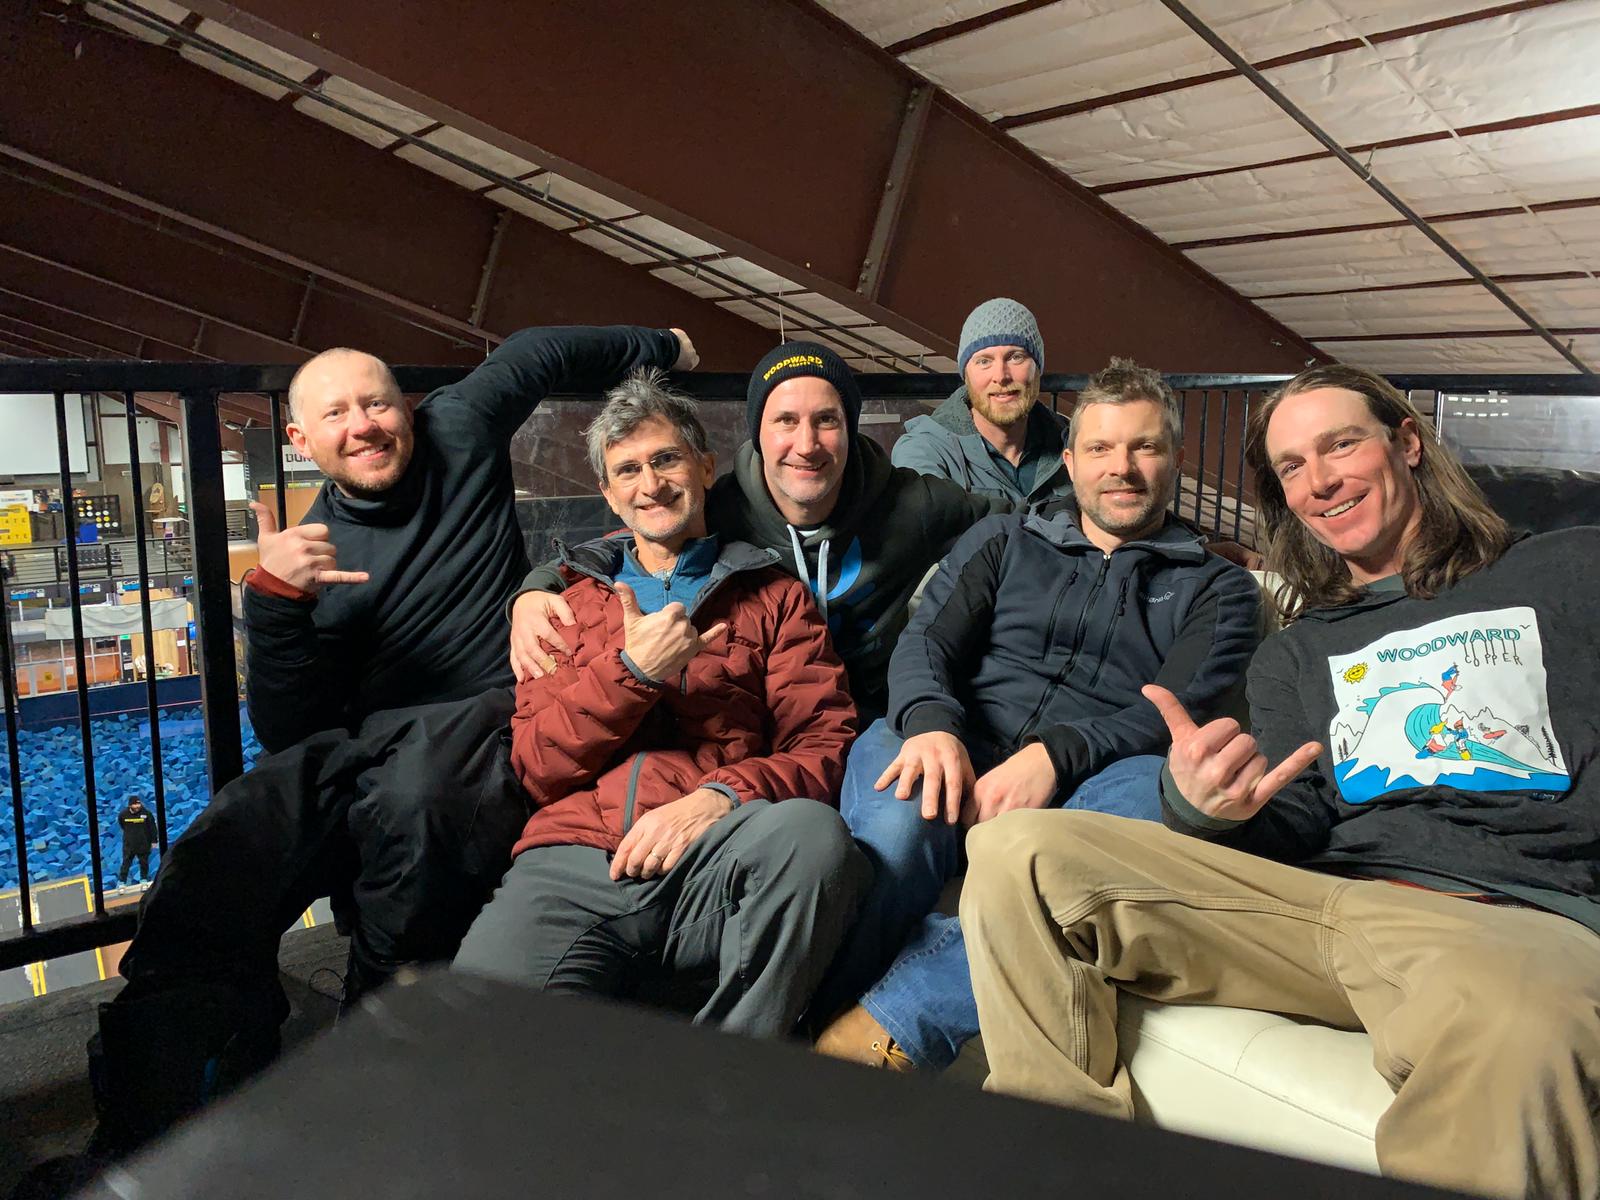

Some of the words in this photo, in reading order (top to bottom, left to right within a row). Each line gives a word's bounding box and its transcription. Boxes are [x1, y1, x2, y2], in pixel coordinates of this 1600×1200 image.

[763, 355, 823, 381] WOODWARD
[1377, 628, 1521, 663] WOODWARD
[1464, 652, 1523, 667] COPPER
